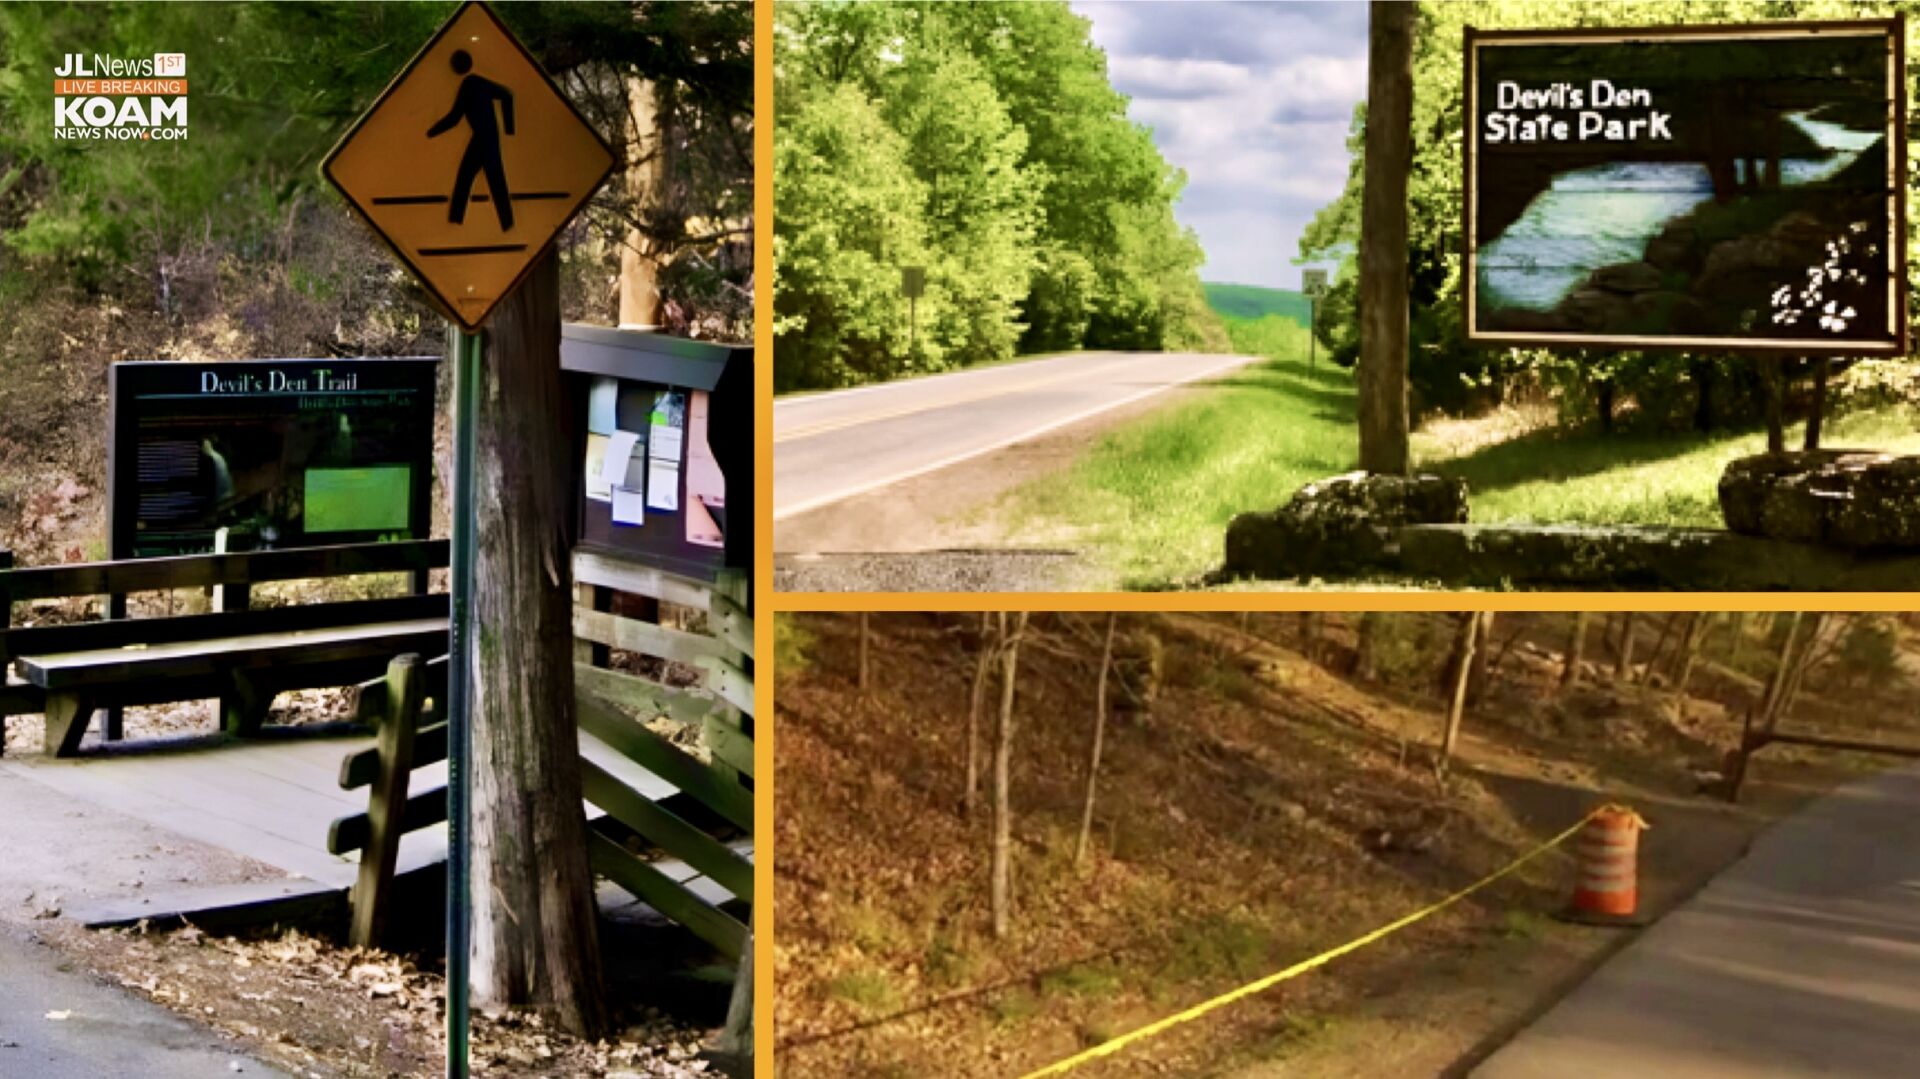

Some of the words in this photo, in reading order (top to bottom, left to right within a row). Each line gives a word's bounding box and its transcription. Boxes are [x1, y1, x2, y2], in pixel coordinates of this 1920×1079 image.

[1497, 81, 1583, 109] Devil's
[1591, 79, 1652, 108] Den
[1484, 111, 1568, 143] State
[1579, 110, 1672, 140] Park
[201, 371, 263, 392] Devil's
[268, 369, 307, 391] Den
[312, 369, 357, 390] Trail
